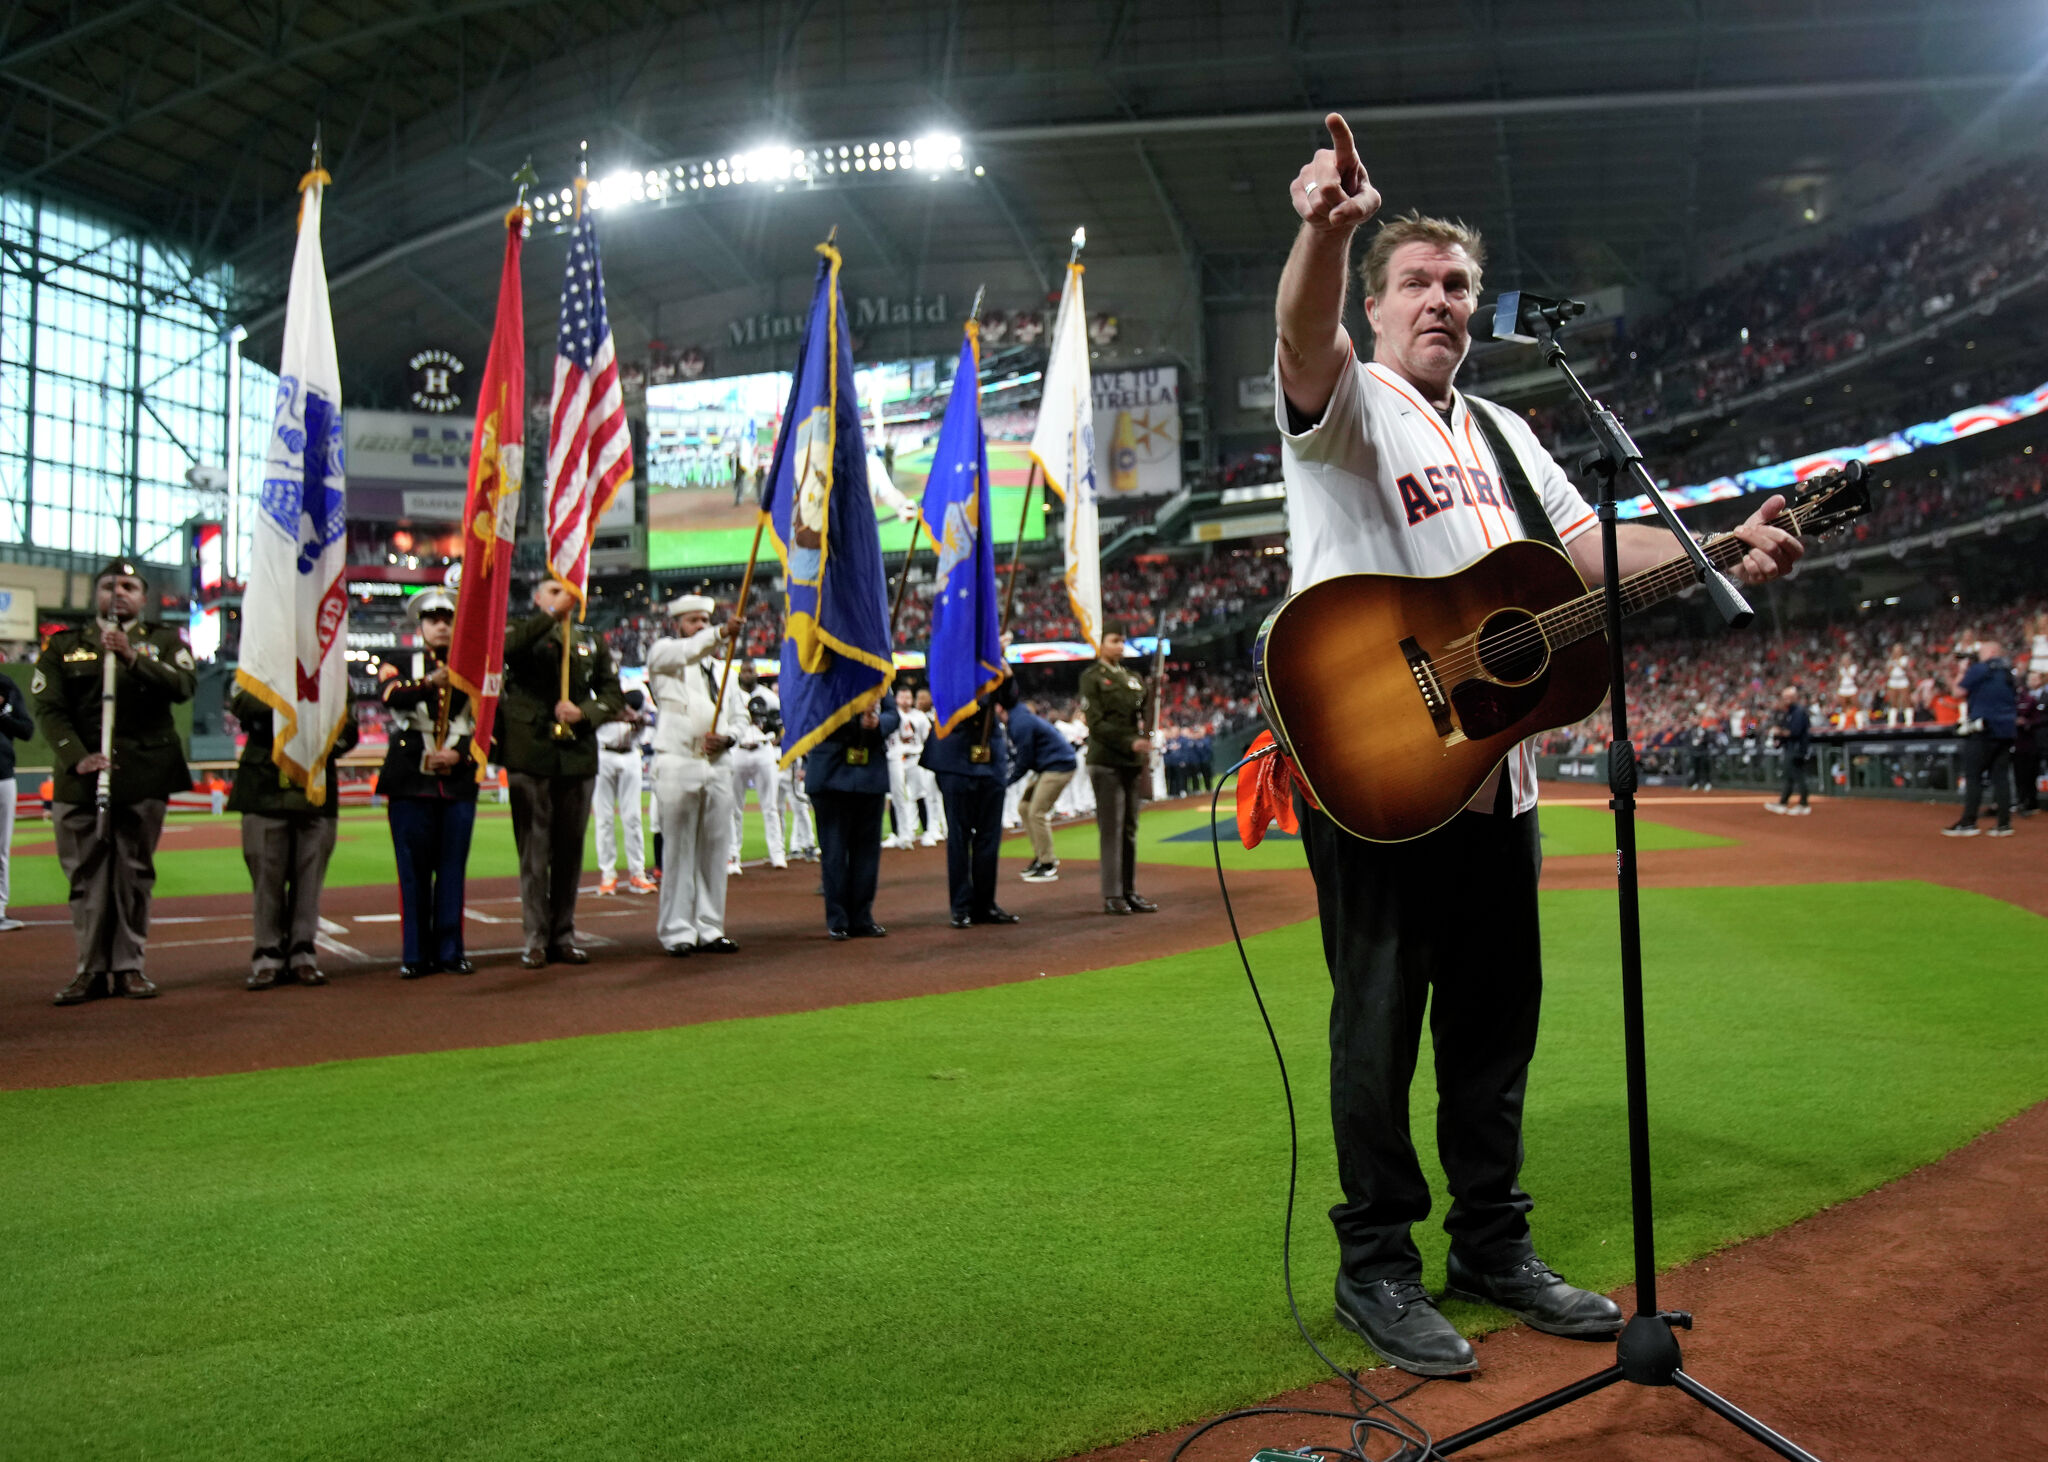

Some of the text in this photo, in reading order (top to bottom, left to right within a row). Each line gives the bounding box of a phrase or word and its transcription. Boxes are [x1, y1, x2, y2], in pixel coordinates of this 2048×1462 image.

[728, 294, 946, 347] Minu Maid
[410, 350, 464, 374] HOUSTON
[425, 368, 449, 394] H
[1396, 464, 1515, 527] ASTR
[347, 632, 396, 649] mpact
